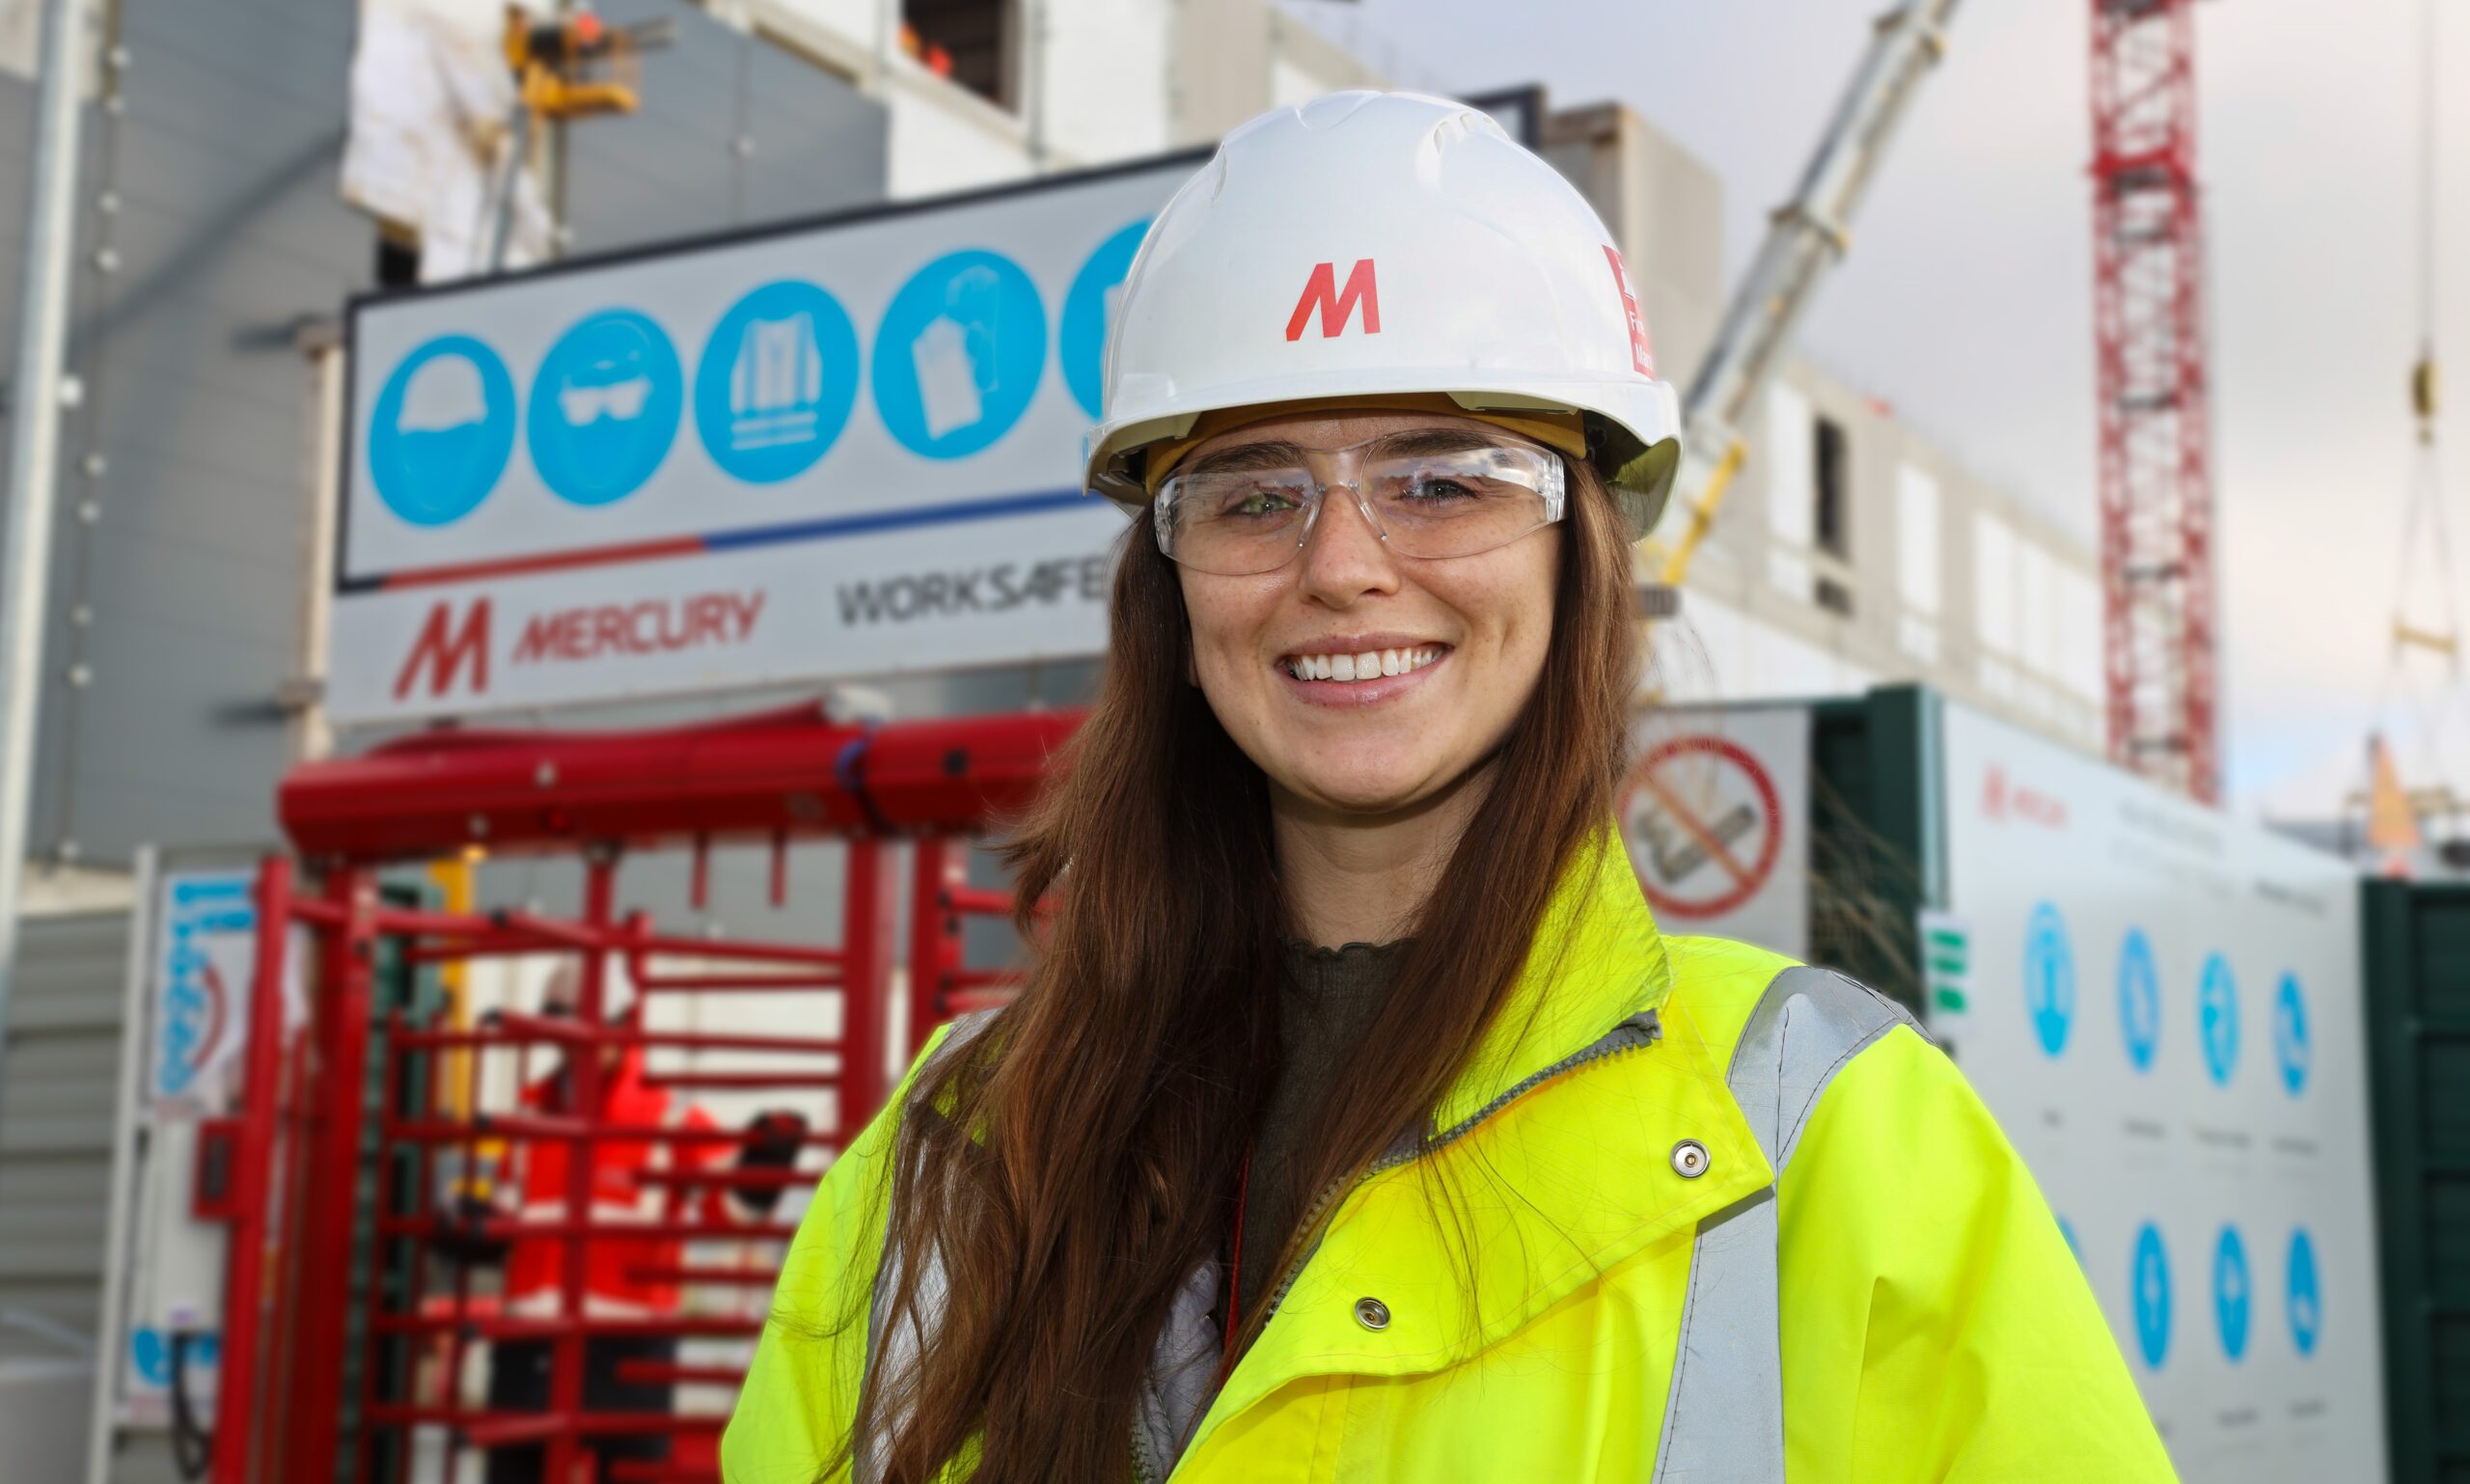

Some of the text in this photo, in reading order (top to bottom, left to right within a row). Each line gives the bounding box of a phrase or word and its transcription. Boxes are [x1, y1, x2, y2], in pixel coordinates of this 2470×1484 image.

[1285, 258, 1381, 342] M
[837, 555, 1108, 627] WORKSAFE
[392, 589, 767, 702] M MERCURY
